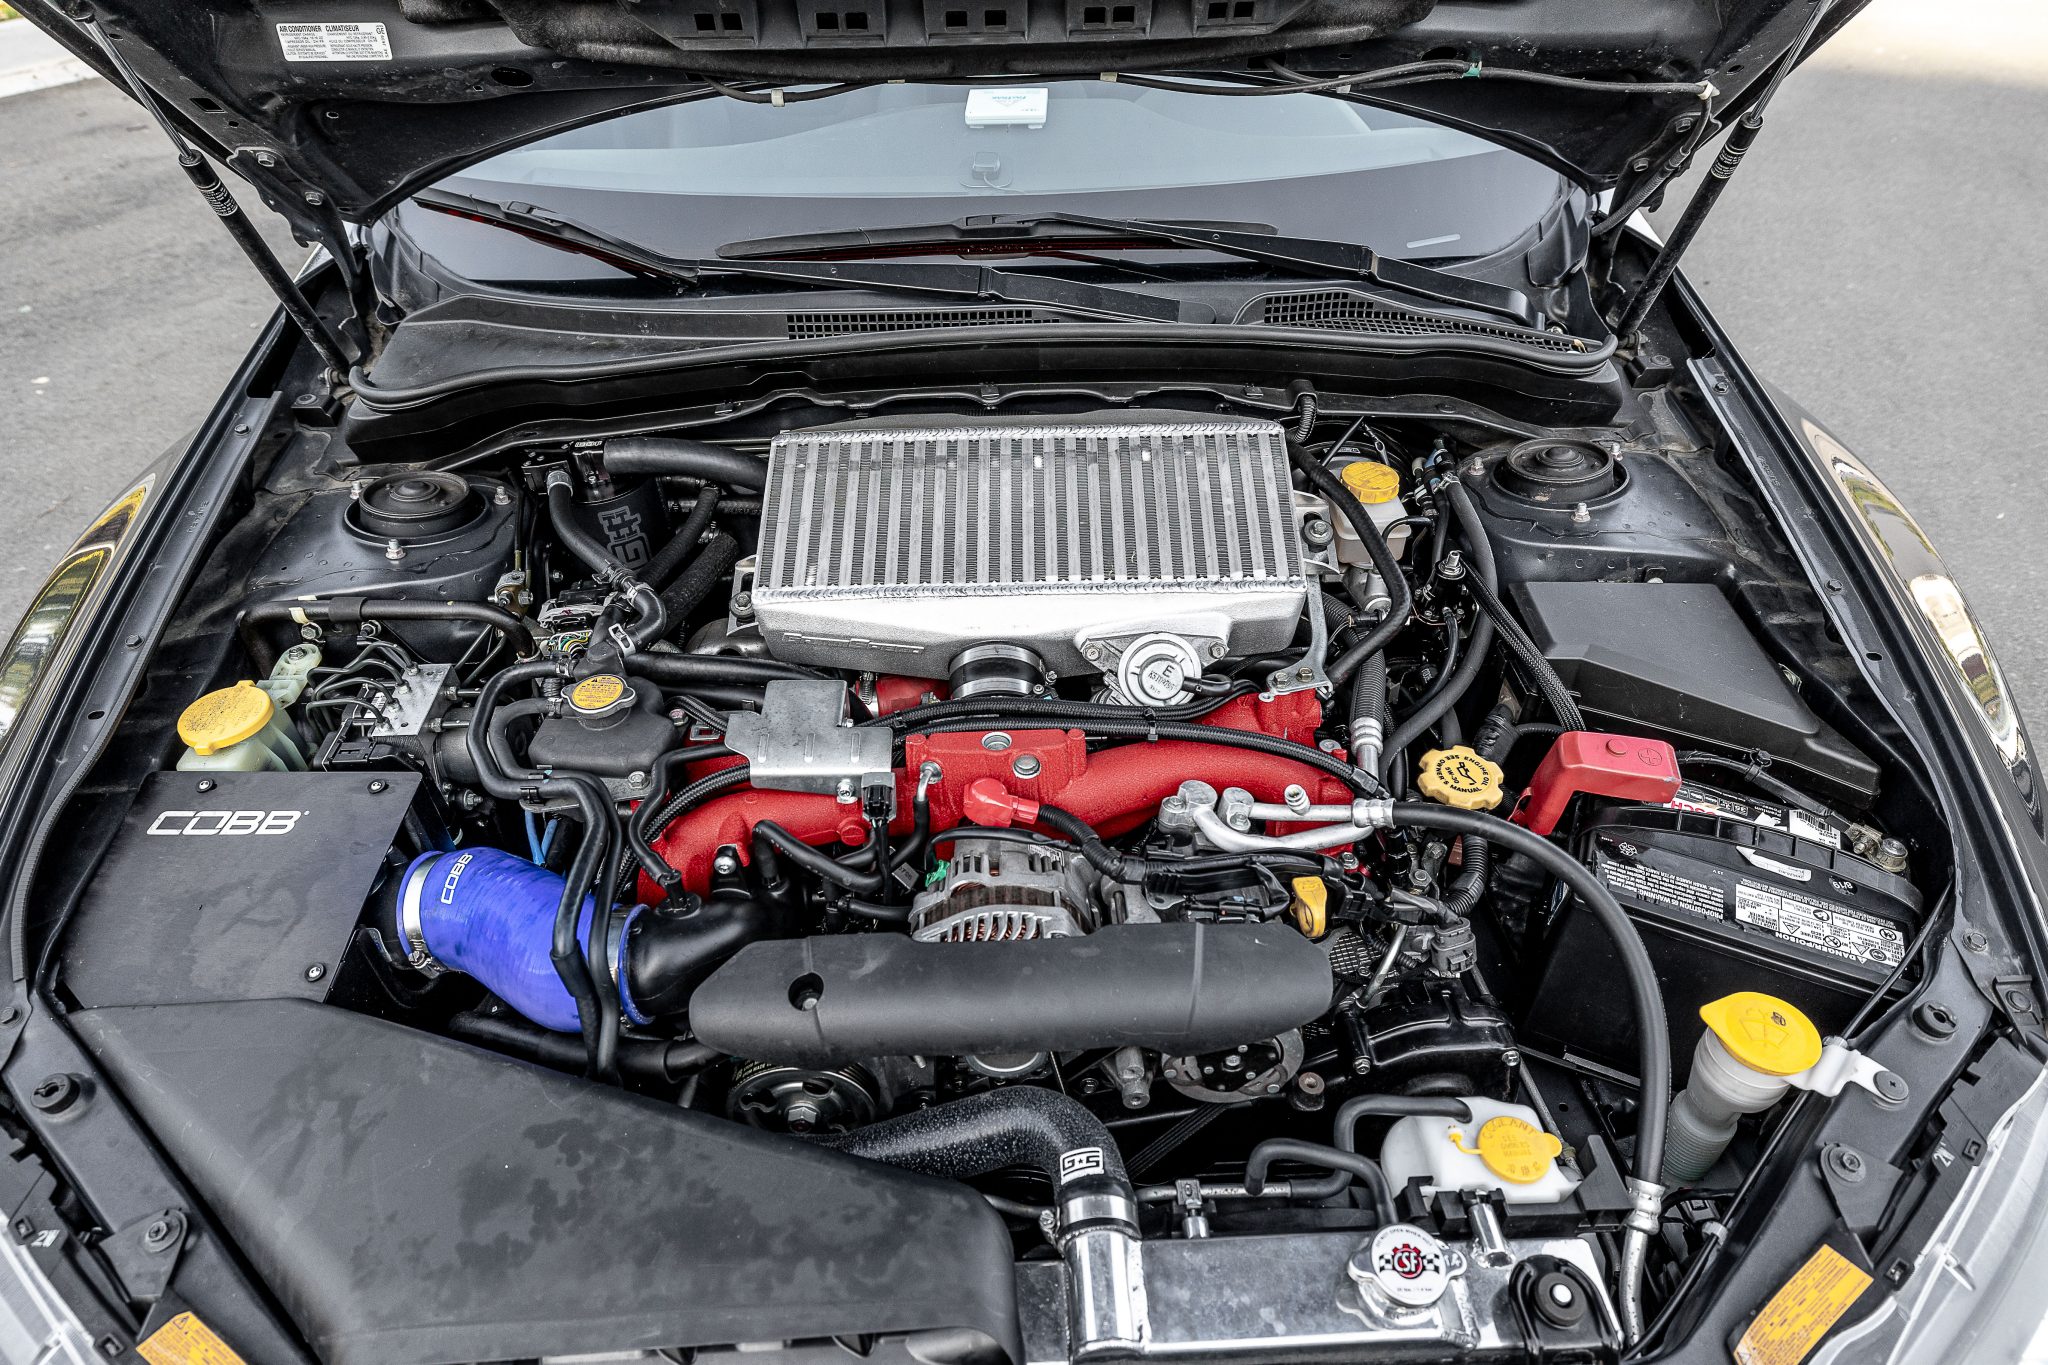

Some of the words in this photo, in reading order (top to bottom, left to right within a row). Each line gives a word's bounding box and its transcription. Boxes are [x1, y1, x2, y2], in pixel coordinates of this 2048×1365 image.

[1436, 759, 1449, 785] OWNER'S
[1449, 784, 1482, 793] MANUAL
[1445, 766, 1460, 784] 5W-30
[1464, 756, 1489, 776] ENGINE
[1481, 776, 1490, 786] OIL
[1753, 805, 1781, 816] Premium
[147, 811, 302, 835] COBB
[440, 854, 473, 904] COBB
[1831, 879, 1853, 891] 8/19
[1637, 887, 1670, 903] WARNING:
[1671, 898, 1678, 906] 65
[1679, 900, 1723, 919] PROPOSITION
[1775, 931, 1856, 961] DANGER/POISON
[1394, 1252, 1418, 1272] CSF
